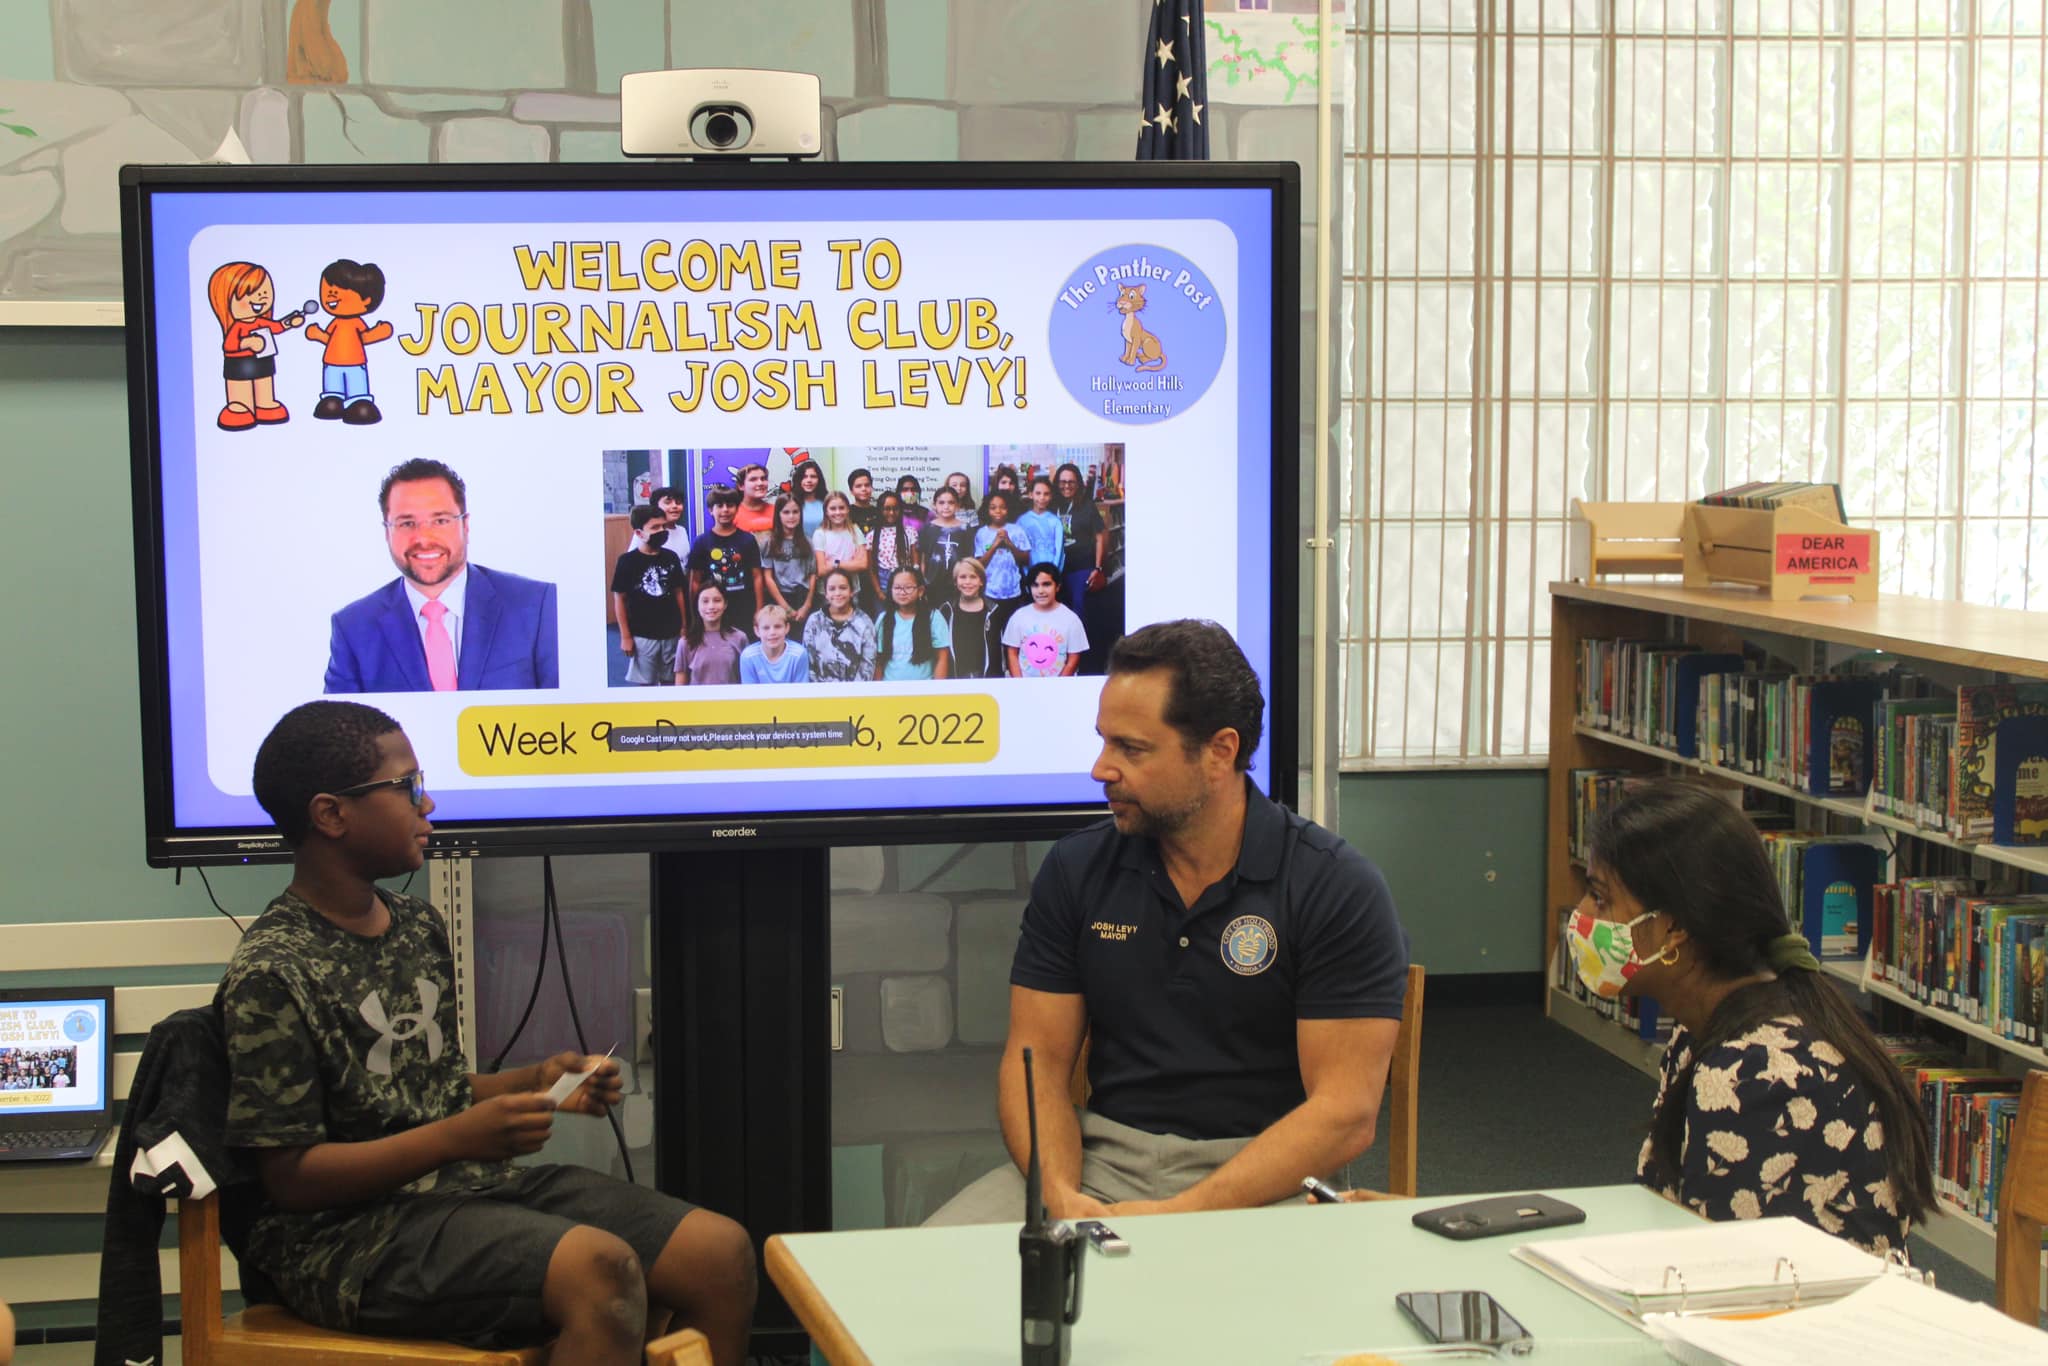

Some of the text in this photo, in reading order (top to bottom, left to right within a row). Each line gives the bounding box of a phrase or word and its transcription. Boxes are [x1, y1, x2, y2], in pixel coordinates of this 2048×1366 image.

[514, 238, 902, 291] WELCOME TO
[1060, 256, 1213, 311] The Panther Post
[399, 297, 1014, 355] JOURNALISM CLUB,
[416, 356, 1028, 415] MAYOR JOSH LEVY!
[1091, 375, 1184, 394] Hollywood Hills
[1103, 399, 1172, 416] Elementary
[1802, 537, 1845, 549] DEAR
[1787, 557, 1858, 570] AMERICA
[478, 721, 577, 756] Week
[898, 712, 984, 746] 2022
[620, 735, 645, 745] Google
[646, 734, 661, 743] Cast
[663, 735, 677, 744] may
[679, 734, 690, 742] not
[734, 732, 755, 741] check
[756, 732, 772, 742] your
[772, 730, 800, 740] device's
[801, 731, 827, 740] system
[827, 729, 843, 738] time
[712, 826, 757, 838] recordex
[1091, 921, 1138, 934] JOSH LEVY
[1100, 931, 1127, 941] MAYOR
